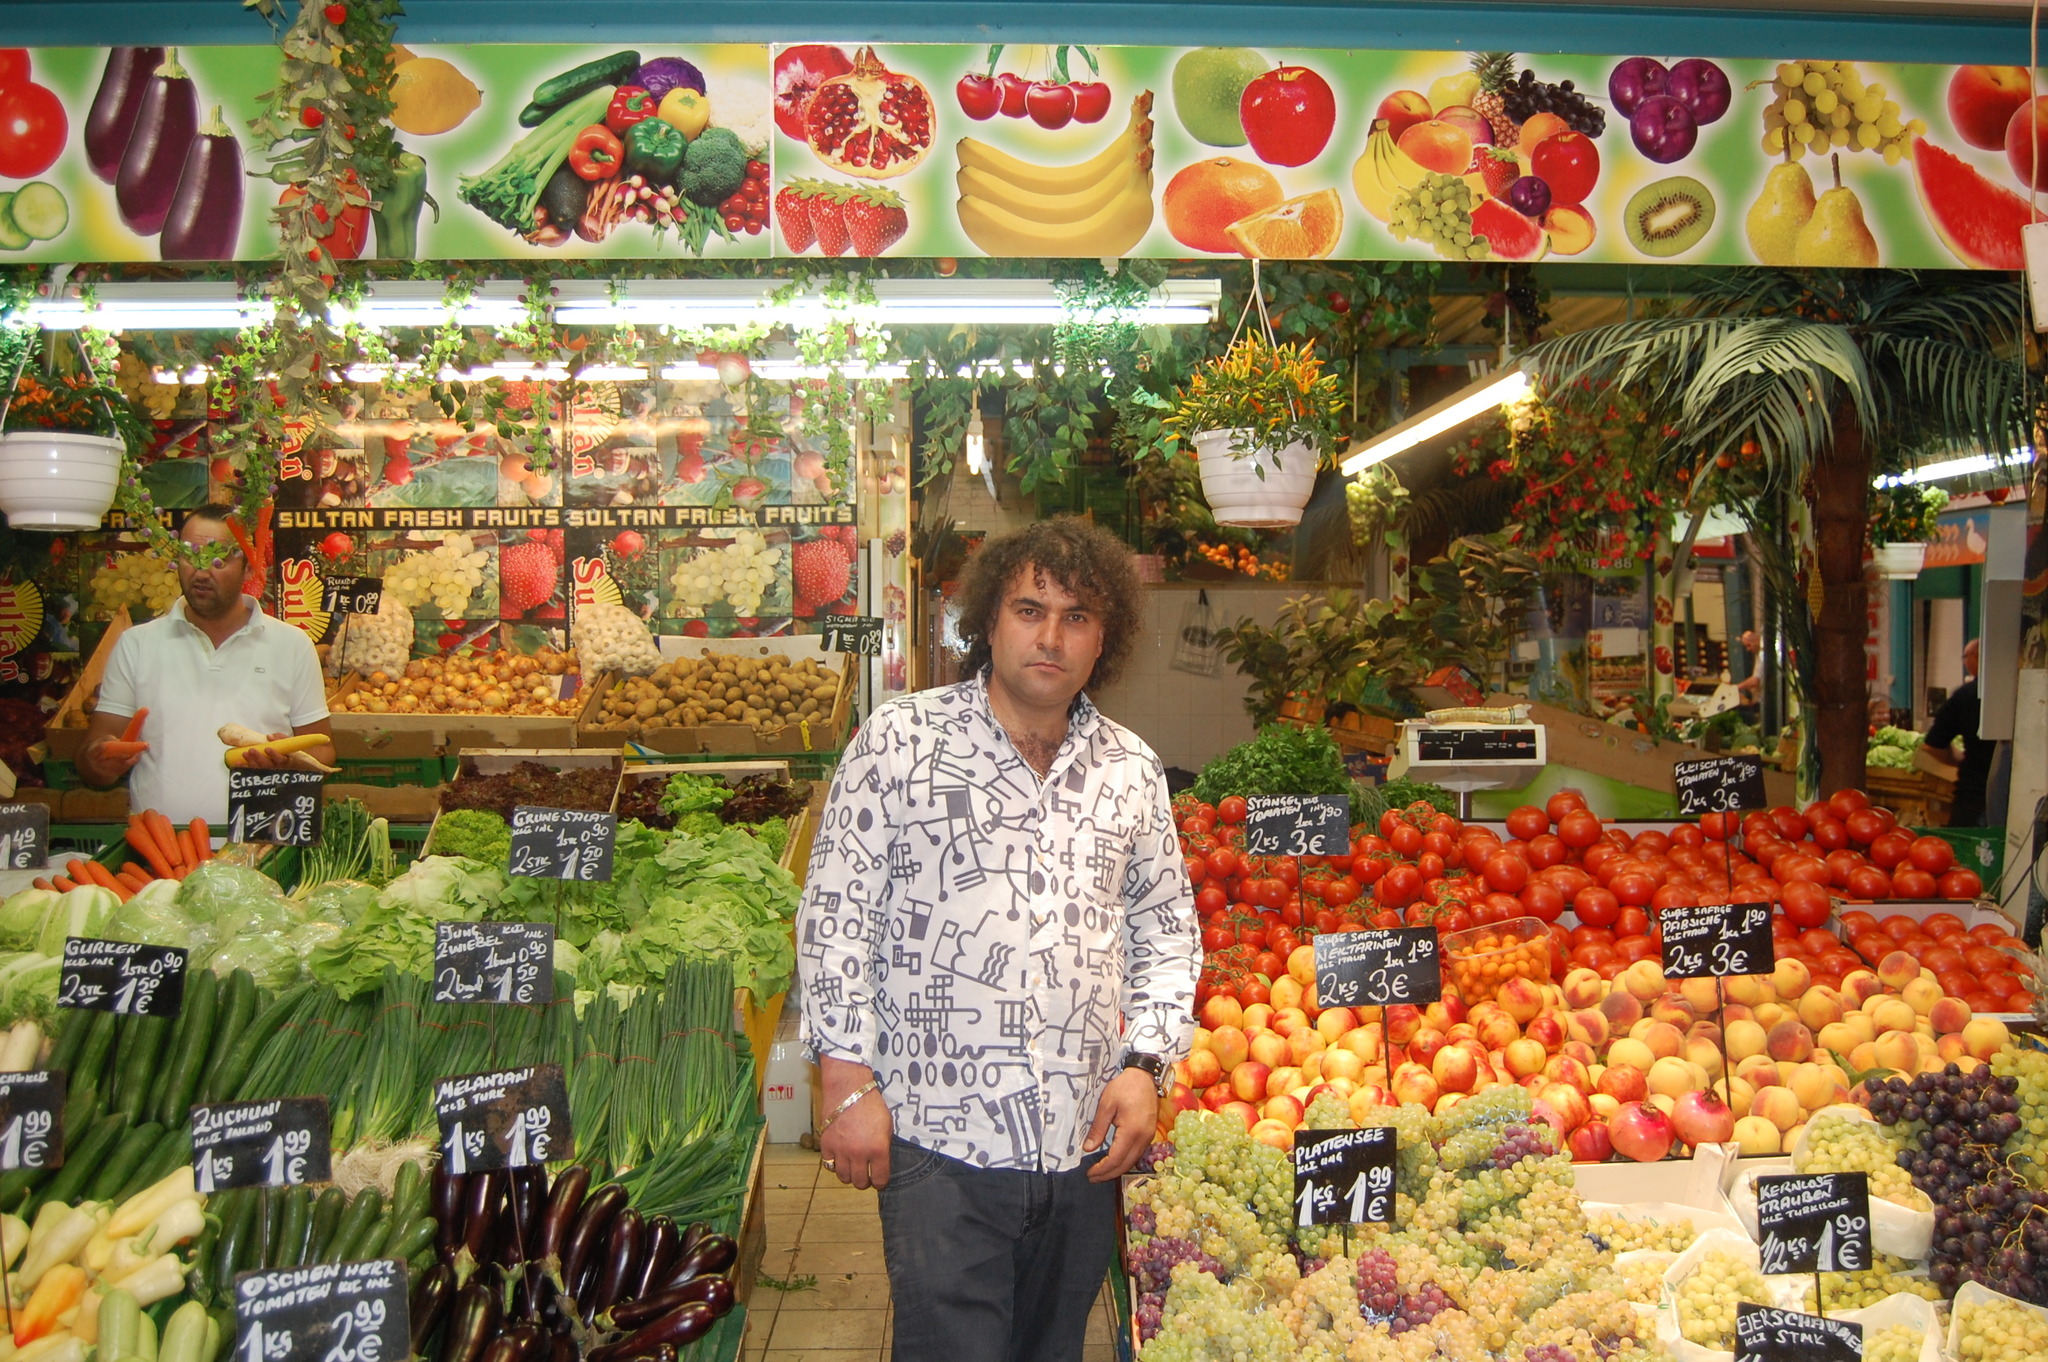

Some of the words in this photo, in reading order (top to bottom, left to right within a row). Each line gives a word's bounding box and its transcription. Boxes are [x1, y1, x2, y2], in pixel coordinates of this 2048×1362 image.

[278, 510, 374, 528] SULTAN
[384, 510, 463, 527] FRESH
[473, 509, 560, 527] FRUITS
[568, 508, 666, 527] SULTAN
[765, 506, 853, 525] FRUITS
[828, 629, 838, 652] 1
[229, 771, 291, 789] EISBERG
[1676, 768, 1720, 787] TOMATEN
[561, 811, 611, 823] SALAT
[1246, 805, 1301, 824] TOMATEN
[65, 939, 142, 956] GURKEN
[436, 934, 504, 960] ZWIEBEL
[1316, 935, 1403, 964] NEKTARINEN
[435, 1067, 535, 1106] MELANZANI
[1759, 1174, 1836, 1201] KERNLOSE
[1758, 1184, 1833, 1214] TRAUBEN
[241, 1263, 341, 1297] OSCHEN
[344, 1259, 396, 1278] HERZ
[238, 1281, 332, 1317] TOMATEN
[1775, 1329, 1826, 1346] STMK
